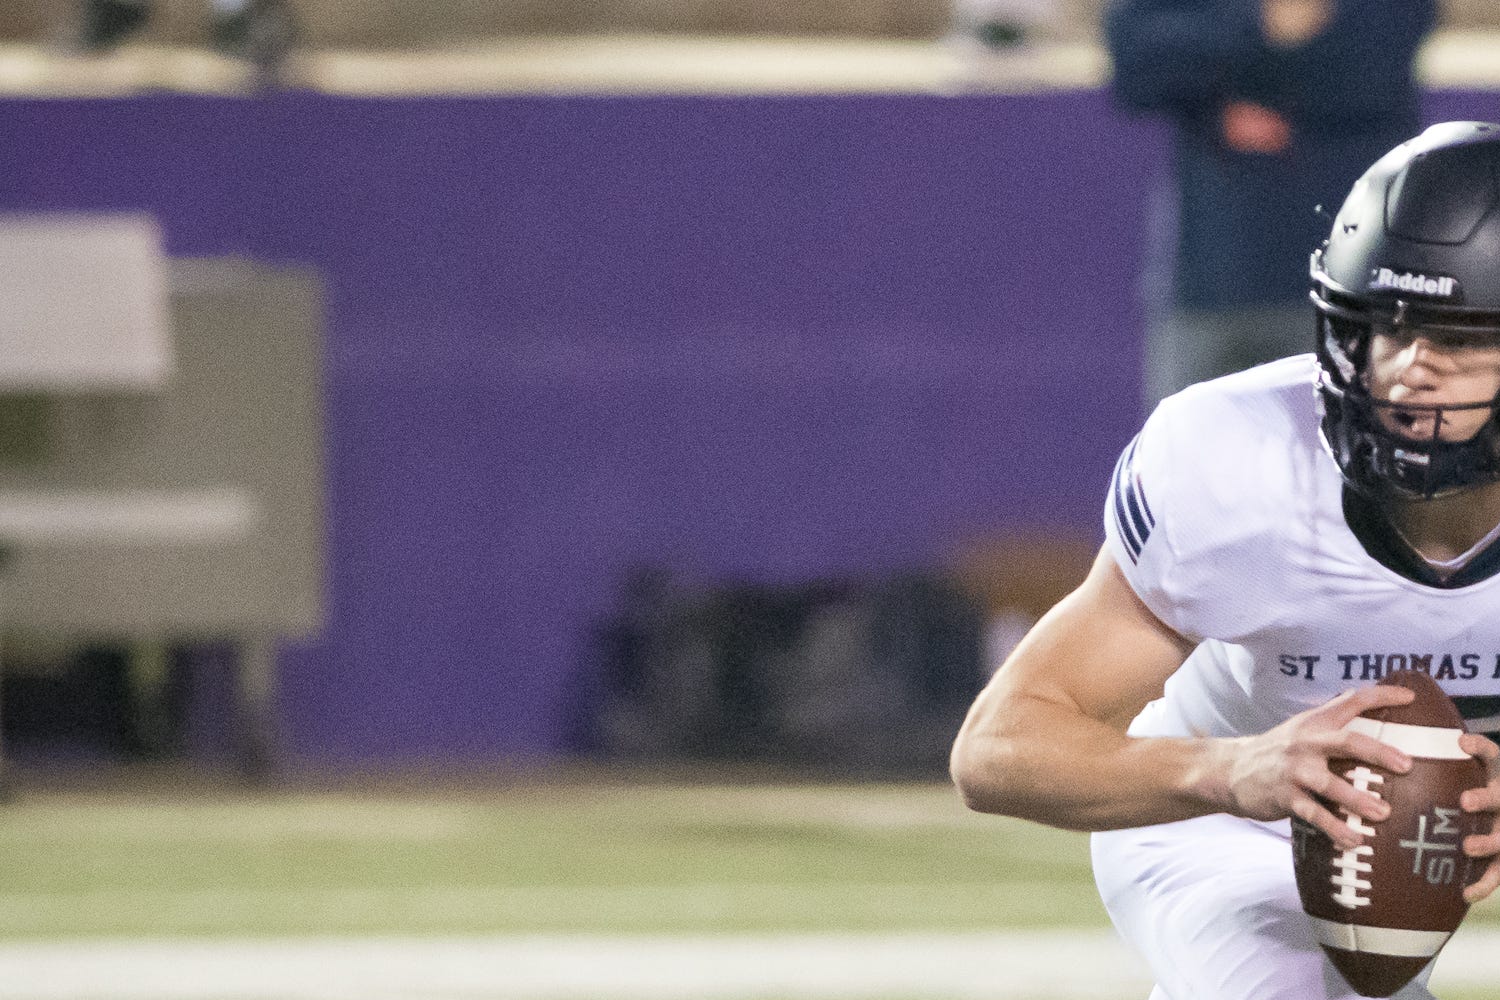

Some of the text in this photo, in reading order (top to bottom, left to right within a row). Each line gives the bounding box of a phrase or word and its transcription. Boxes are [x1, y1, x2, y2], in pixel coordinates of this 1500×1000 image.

[1378, 267, 1454, 296] Riddell
[1279, 654, 1321, 681] ST
[1337, 653, 1480, 680] THOMAS
